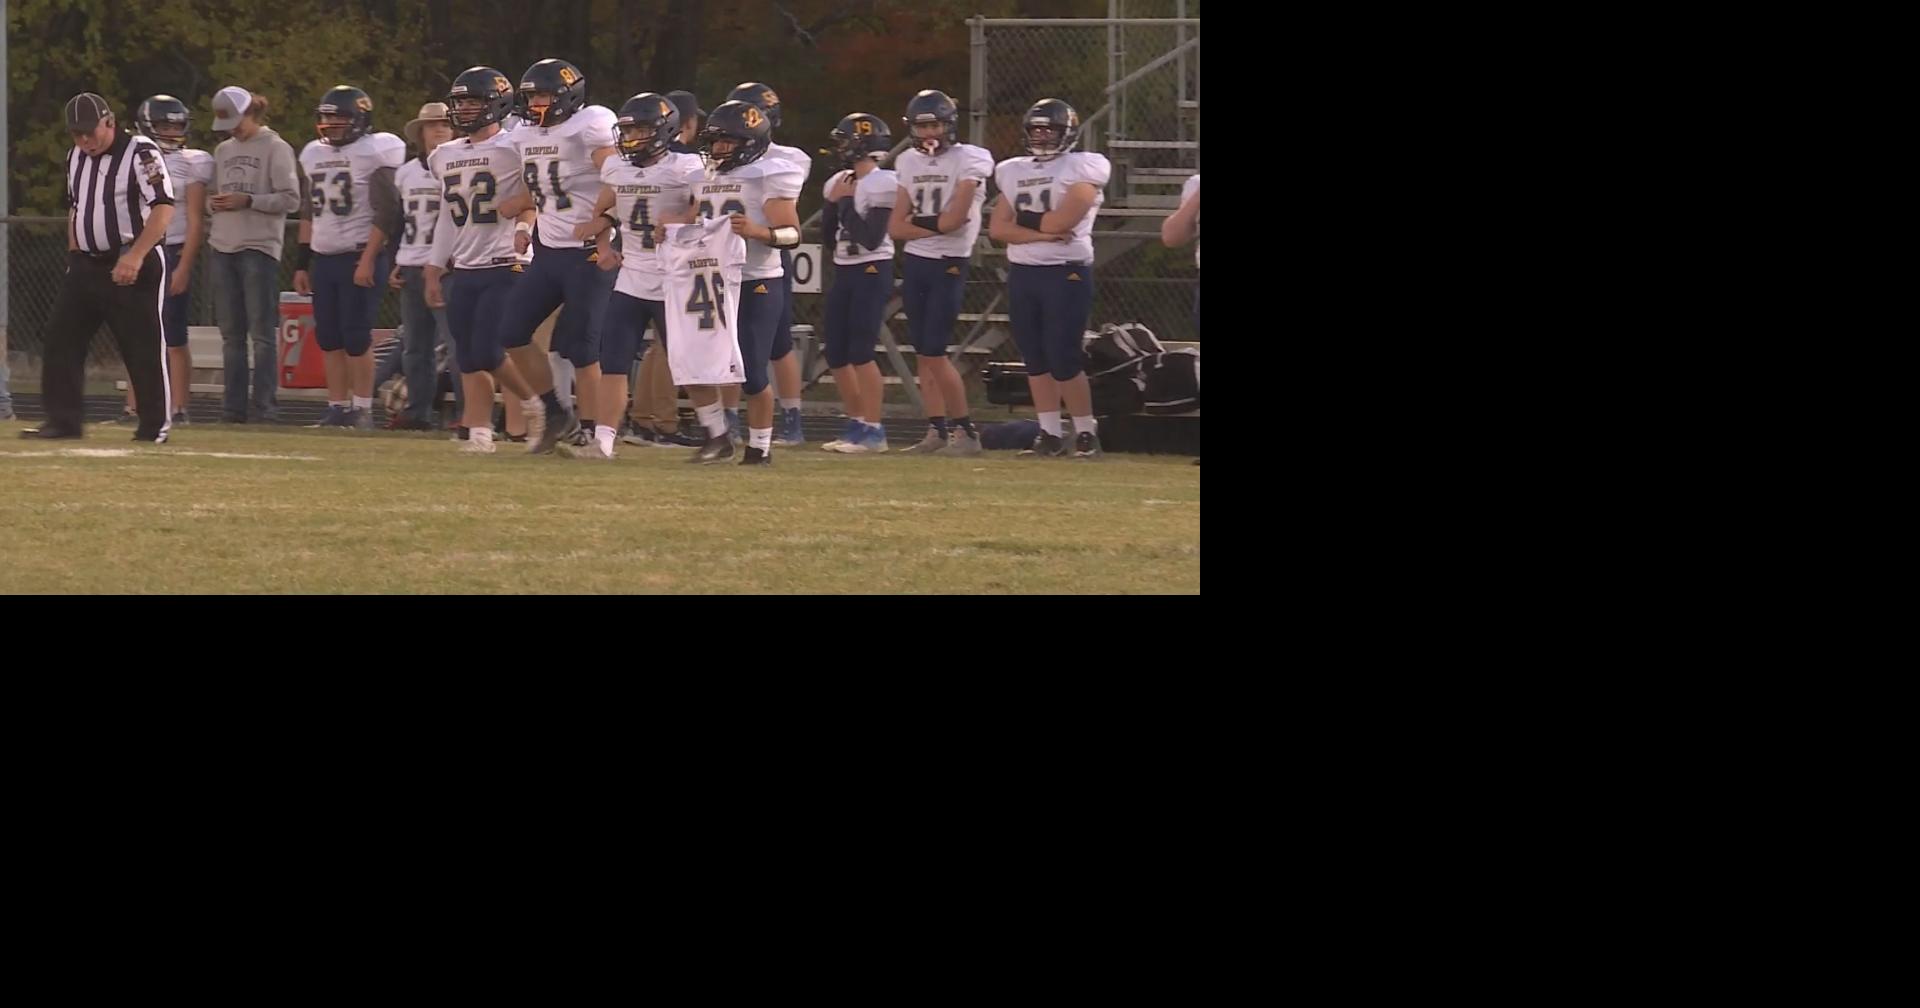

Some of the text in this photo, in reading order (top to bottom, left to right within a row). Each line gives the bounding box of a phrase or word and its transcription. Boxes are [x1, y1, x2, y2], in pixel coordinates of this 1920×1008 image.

[854, 120, 874, 136] 19
[445, 157, 490, 171] FAIRFIELD
[525, 146, 560, 157] FAIRFIELD
[310, 171, 354, 218] 53
[442, 170, 499, 229] 52
[628, 197, 656, 250] 4
[282, 318, 300, 344] G
